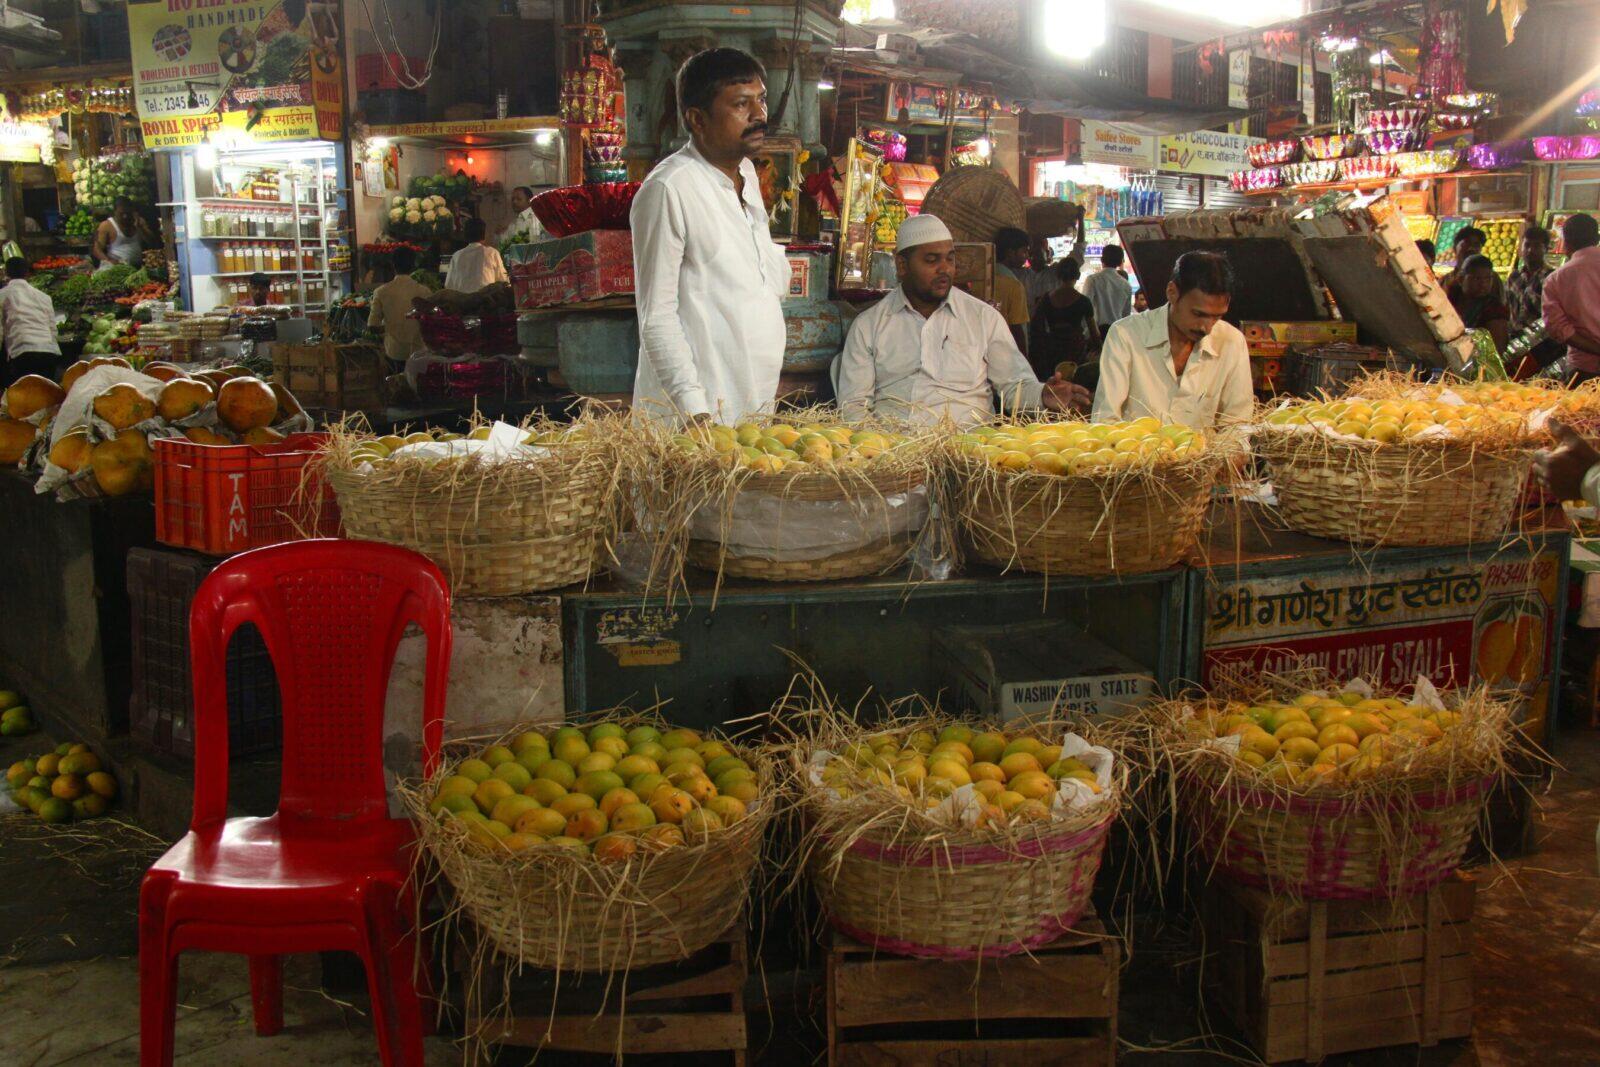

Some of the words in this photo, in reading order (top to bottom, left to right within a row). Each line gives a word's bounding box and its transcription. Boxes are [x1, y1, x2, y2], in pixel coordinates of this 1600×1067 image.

[187, 7, 265, 29] HANDMADE
[139, 66, 180, 81] WHOLESALER
[182, 65, 188, 77] &
[189, 62, 220, 77] RETAILER
[165, 96, 187, 111] 2345
[141, 119, 180, 137] ROYAL
[181, 116, 221, 134] SPICES
[154, 138, 162, 146] &
[163, 135, 179, 146] DRY
[1095, 129, 1118, 143] Saifee
[1118, 132, 1142, 146] Stores
[1190, 132, 1240, 150] CHOCOLATE
[543, 275, 569, 287] APPLE
[228, 473, 248, 543] TAM
[1256, 580, 1343, 628] गणेश
[1399, 567, 1483, 610] स्टॉल
[1390, 637, 1445, 685] STALL
[1012, 683, 1092, 704] WASHINGTON
[1100, 678, 1139, 697] STATE
